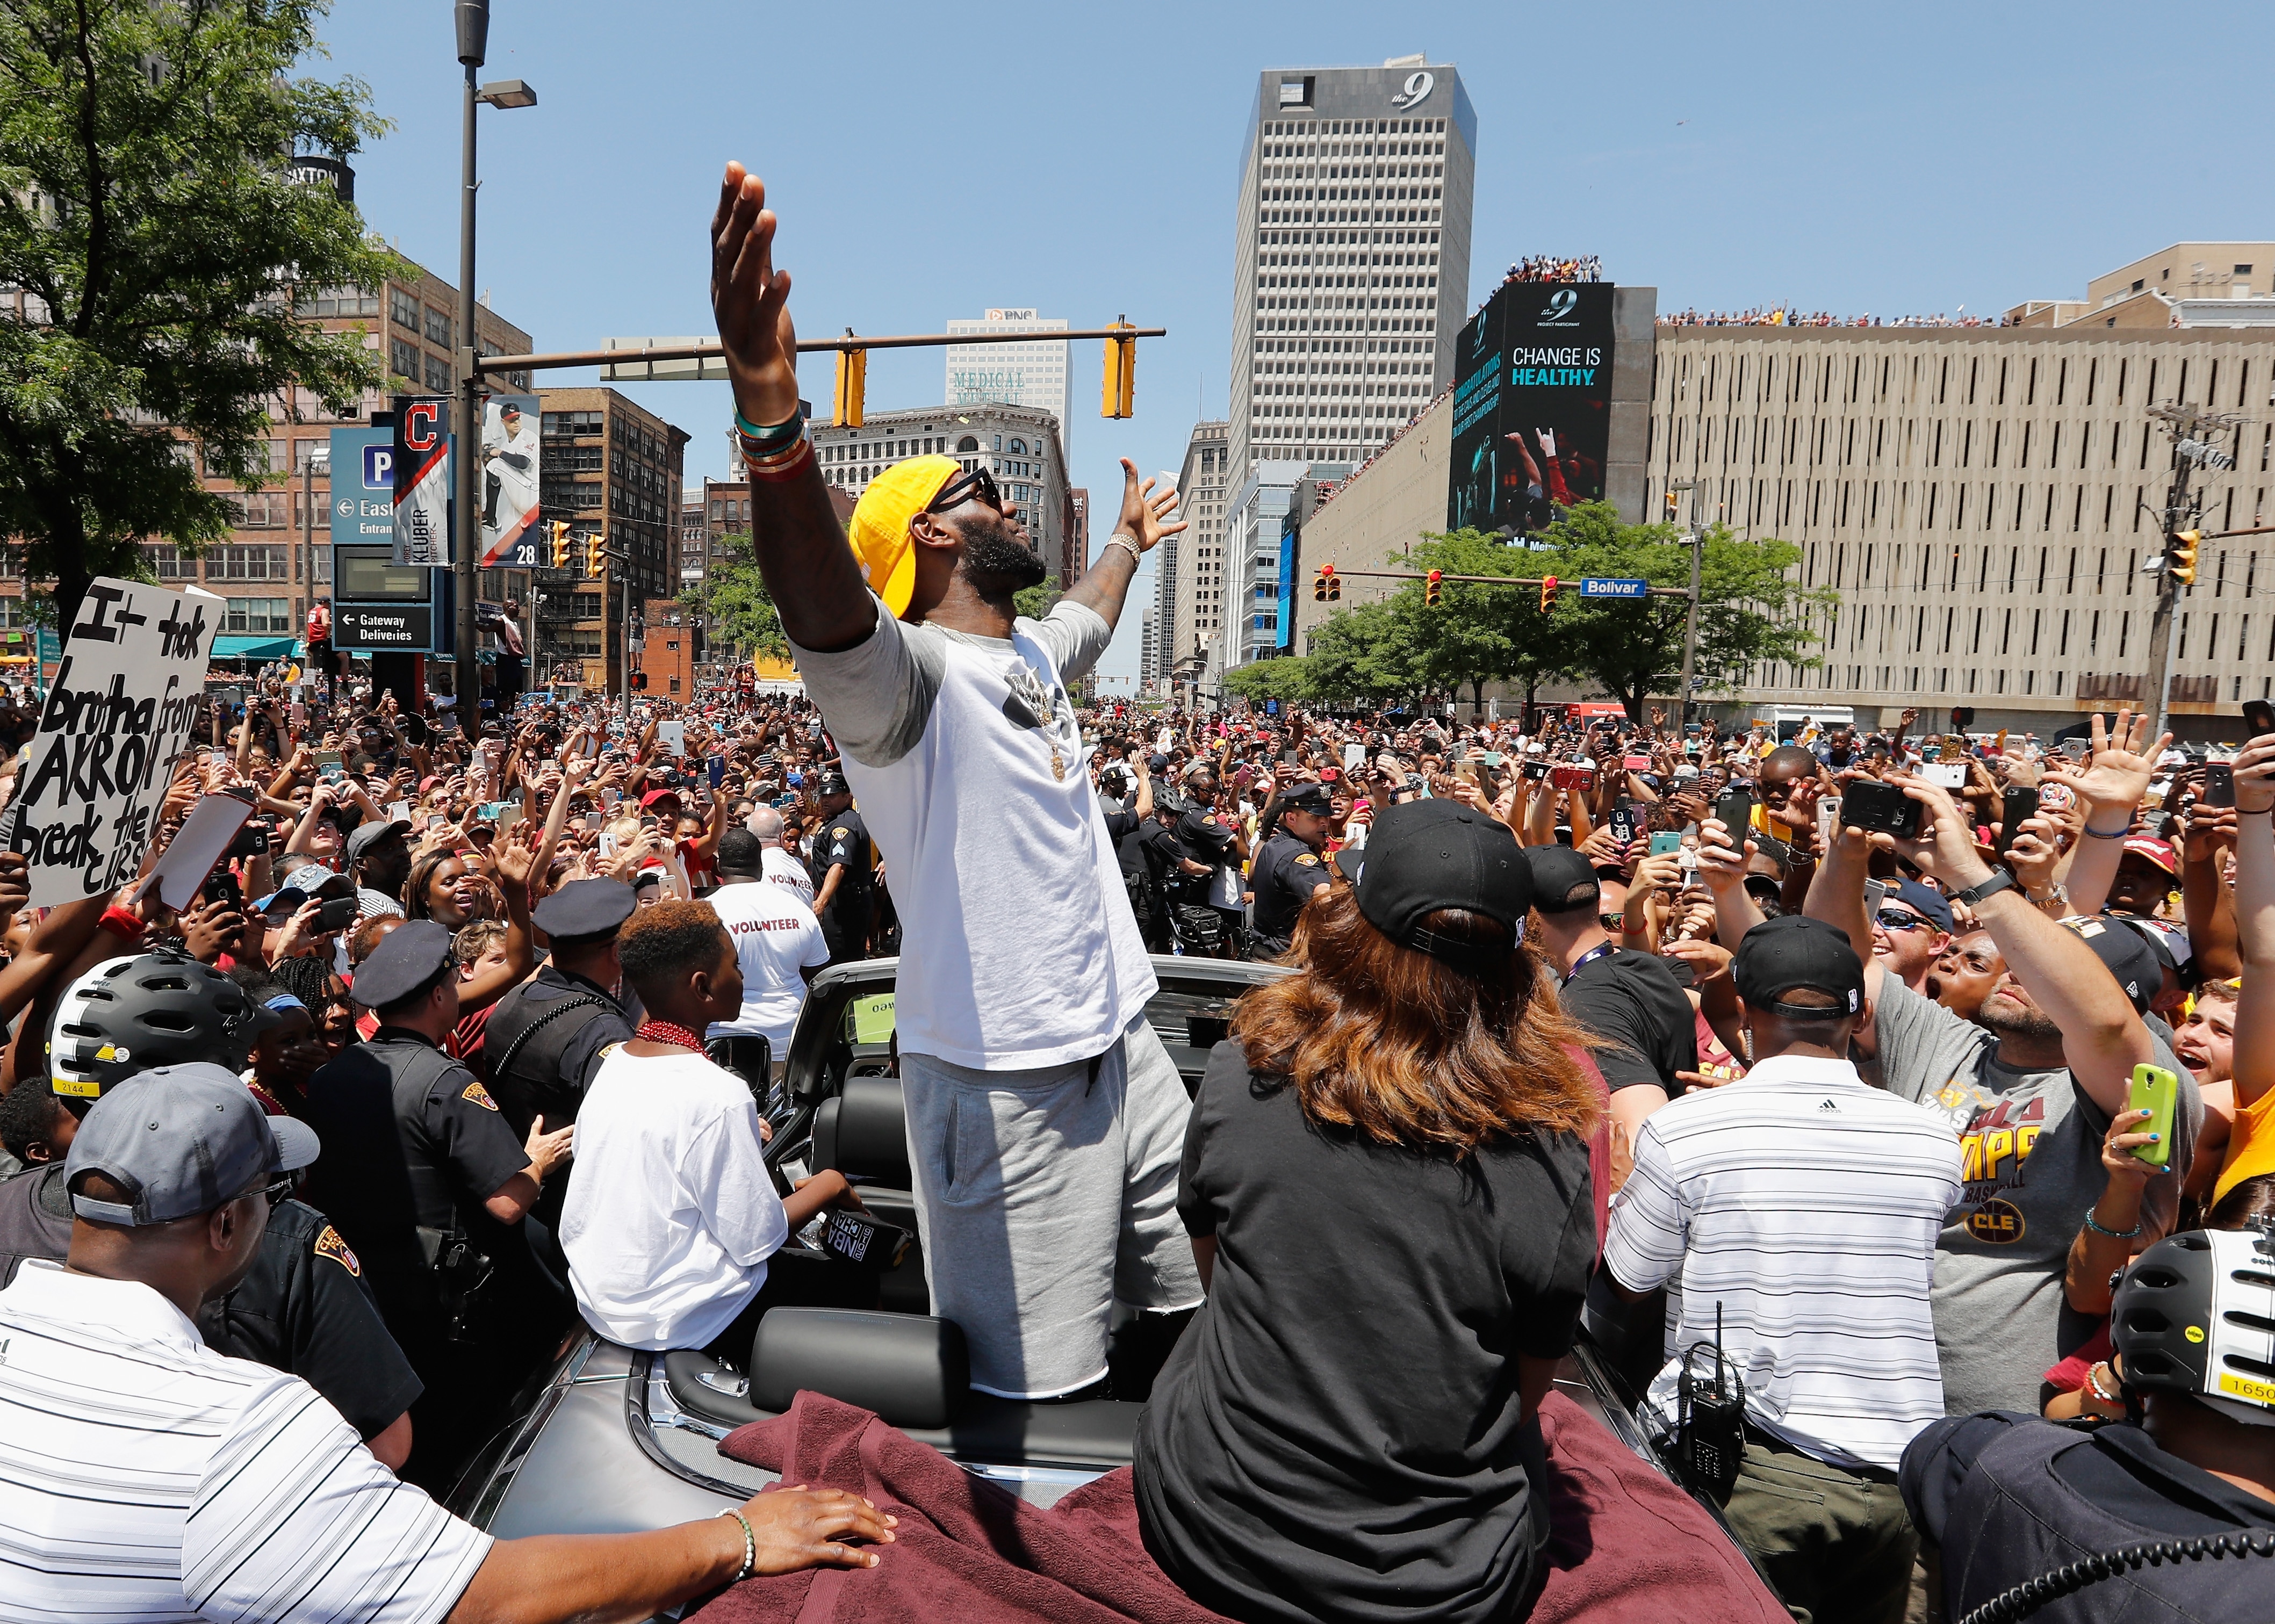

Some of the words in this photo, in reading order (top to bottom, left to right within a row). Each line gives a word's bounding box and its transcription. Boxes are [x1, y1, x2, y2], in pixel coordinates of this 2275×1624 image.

[1392, 93, 1408, 103] the
[1399, 71, 1434, 110] 9
[1547, 289, 1578, 321] 9
[1004, 311, 1032, 320] PNC
[1513, 348, 1581, 365] CHANGE
[1586, 348, 1601, 365] IS
[954, 372, 1024, 387] MEDICAL
[1512, 369, 1595, 386] HEALTHY.
[405, 403, 438, 451] C
[373, 452, 393, 481] P
[360, 523, 392, 534] Entran
[413, 509, 428, 564] KLUBER
[516, 545, 535, 565] 28
[1588, 581, 1638, 594] Bolivar
[360, 615, 405, 627] Gateway
[360, 629, 412, 641] Deliveries
[10, 803, 102, 869] break
[83, 839, 146, 895] CURS
[730, 918, 800, 935] VOLUNTEER
[62, 1083, 84, 1093] 2144
[1973, 1214, 2014, 1230] CLE
[827, 1224, 857, 1258] NBA
[855, 1228, 871, 1259] 2016
